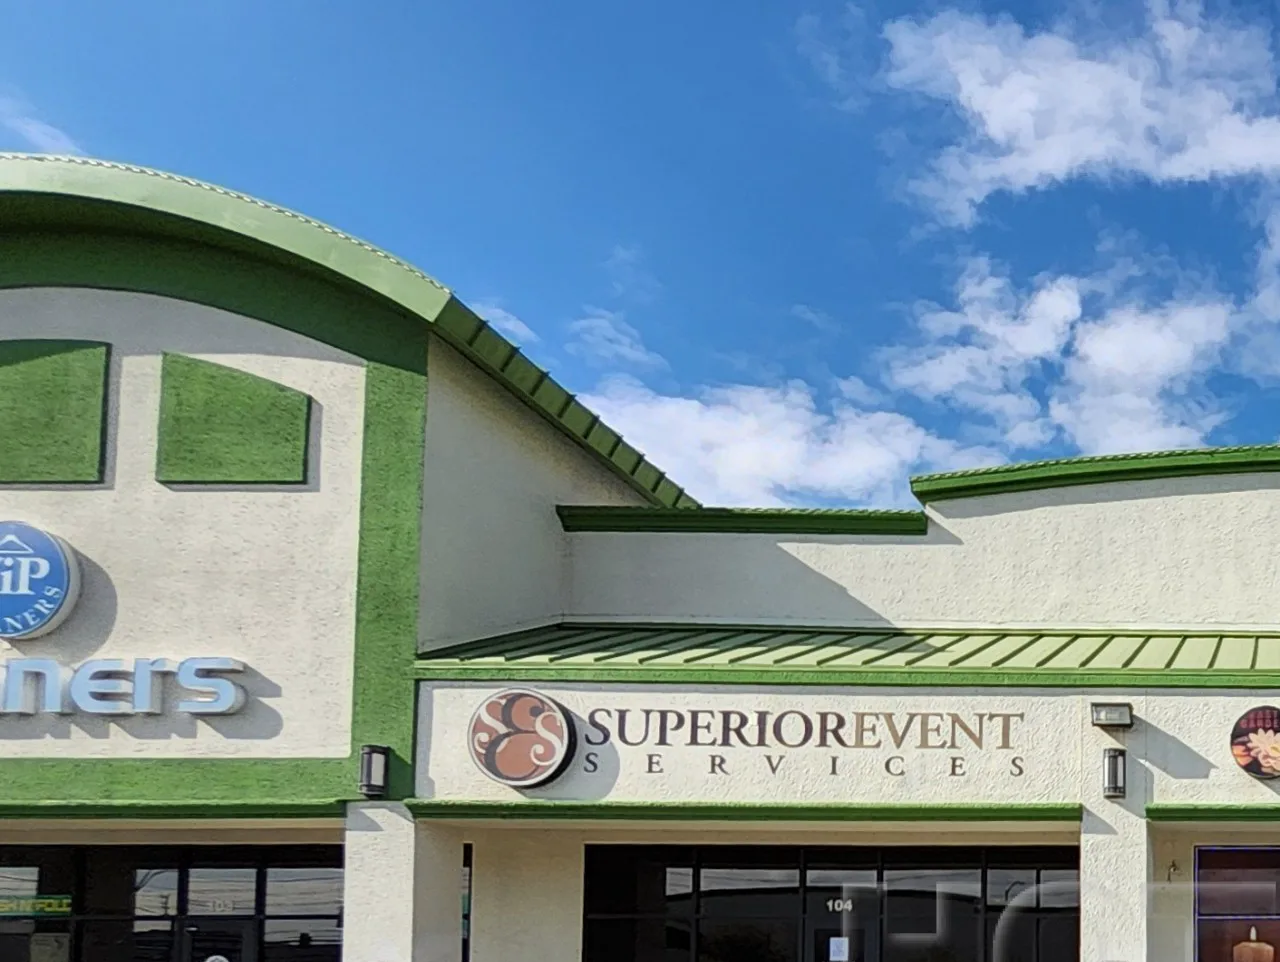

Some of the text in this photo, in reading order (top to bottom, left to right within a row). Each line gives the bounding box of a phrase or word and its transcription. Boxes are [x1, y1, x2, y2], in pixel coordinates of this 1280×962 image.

[0, 555, 50, 595] iP
[0, 586, 62, 633] NERS
[583, 752, 1025, 777] SERVICES
[826, 899, 853, 912] 104
